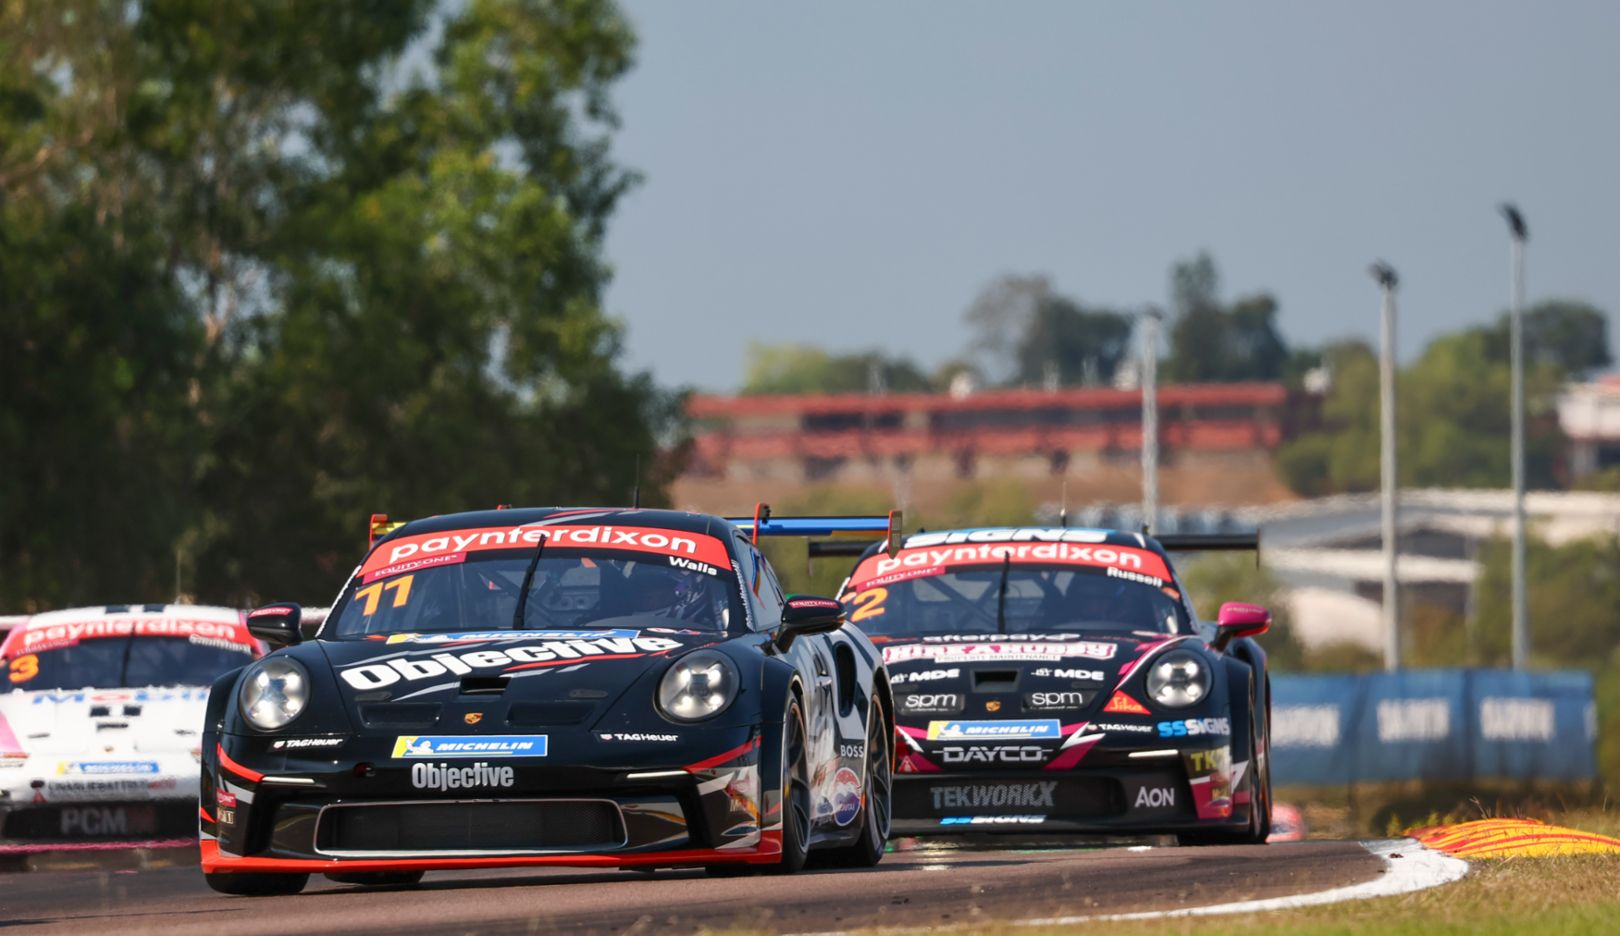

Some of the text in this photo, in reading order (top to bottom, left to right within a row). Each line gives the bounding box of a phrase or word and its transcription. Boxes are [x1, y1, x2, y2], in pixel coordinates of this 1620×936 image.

[390, 527, 696, 563] paynterdixon
[669, 556, 717, 576] Walls
[876, 543, 1142, 576] paynterdixon
[1107, 566, 1162, 588] Russell
[355, 575, 414, 616] 11
[852, 588, 888, 622] 2
[922, 634, 1047, 642] afterpay
[9, 655, 39, 682] 3
[341, 637, 684, 690] Objective
[909, 669, 960, 682] MDE
[1054, 669, 1105, 681] MDE
[905, 694, 957, 708] spm
[1032, 692, 1083, 705] spm
[1110, 697, 1143, 711] Sika
[966, 725, 1050, 734] MICHELIN
[435, 740, 534, 751] MICHELIN
[840, 745, 864, 757] BOSS
[411, 762, 514, 792] Objective
[1134, 786, 1175, 808] AON
[61, 806, 127, 835] PCM
